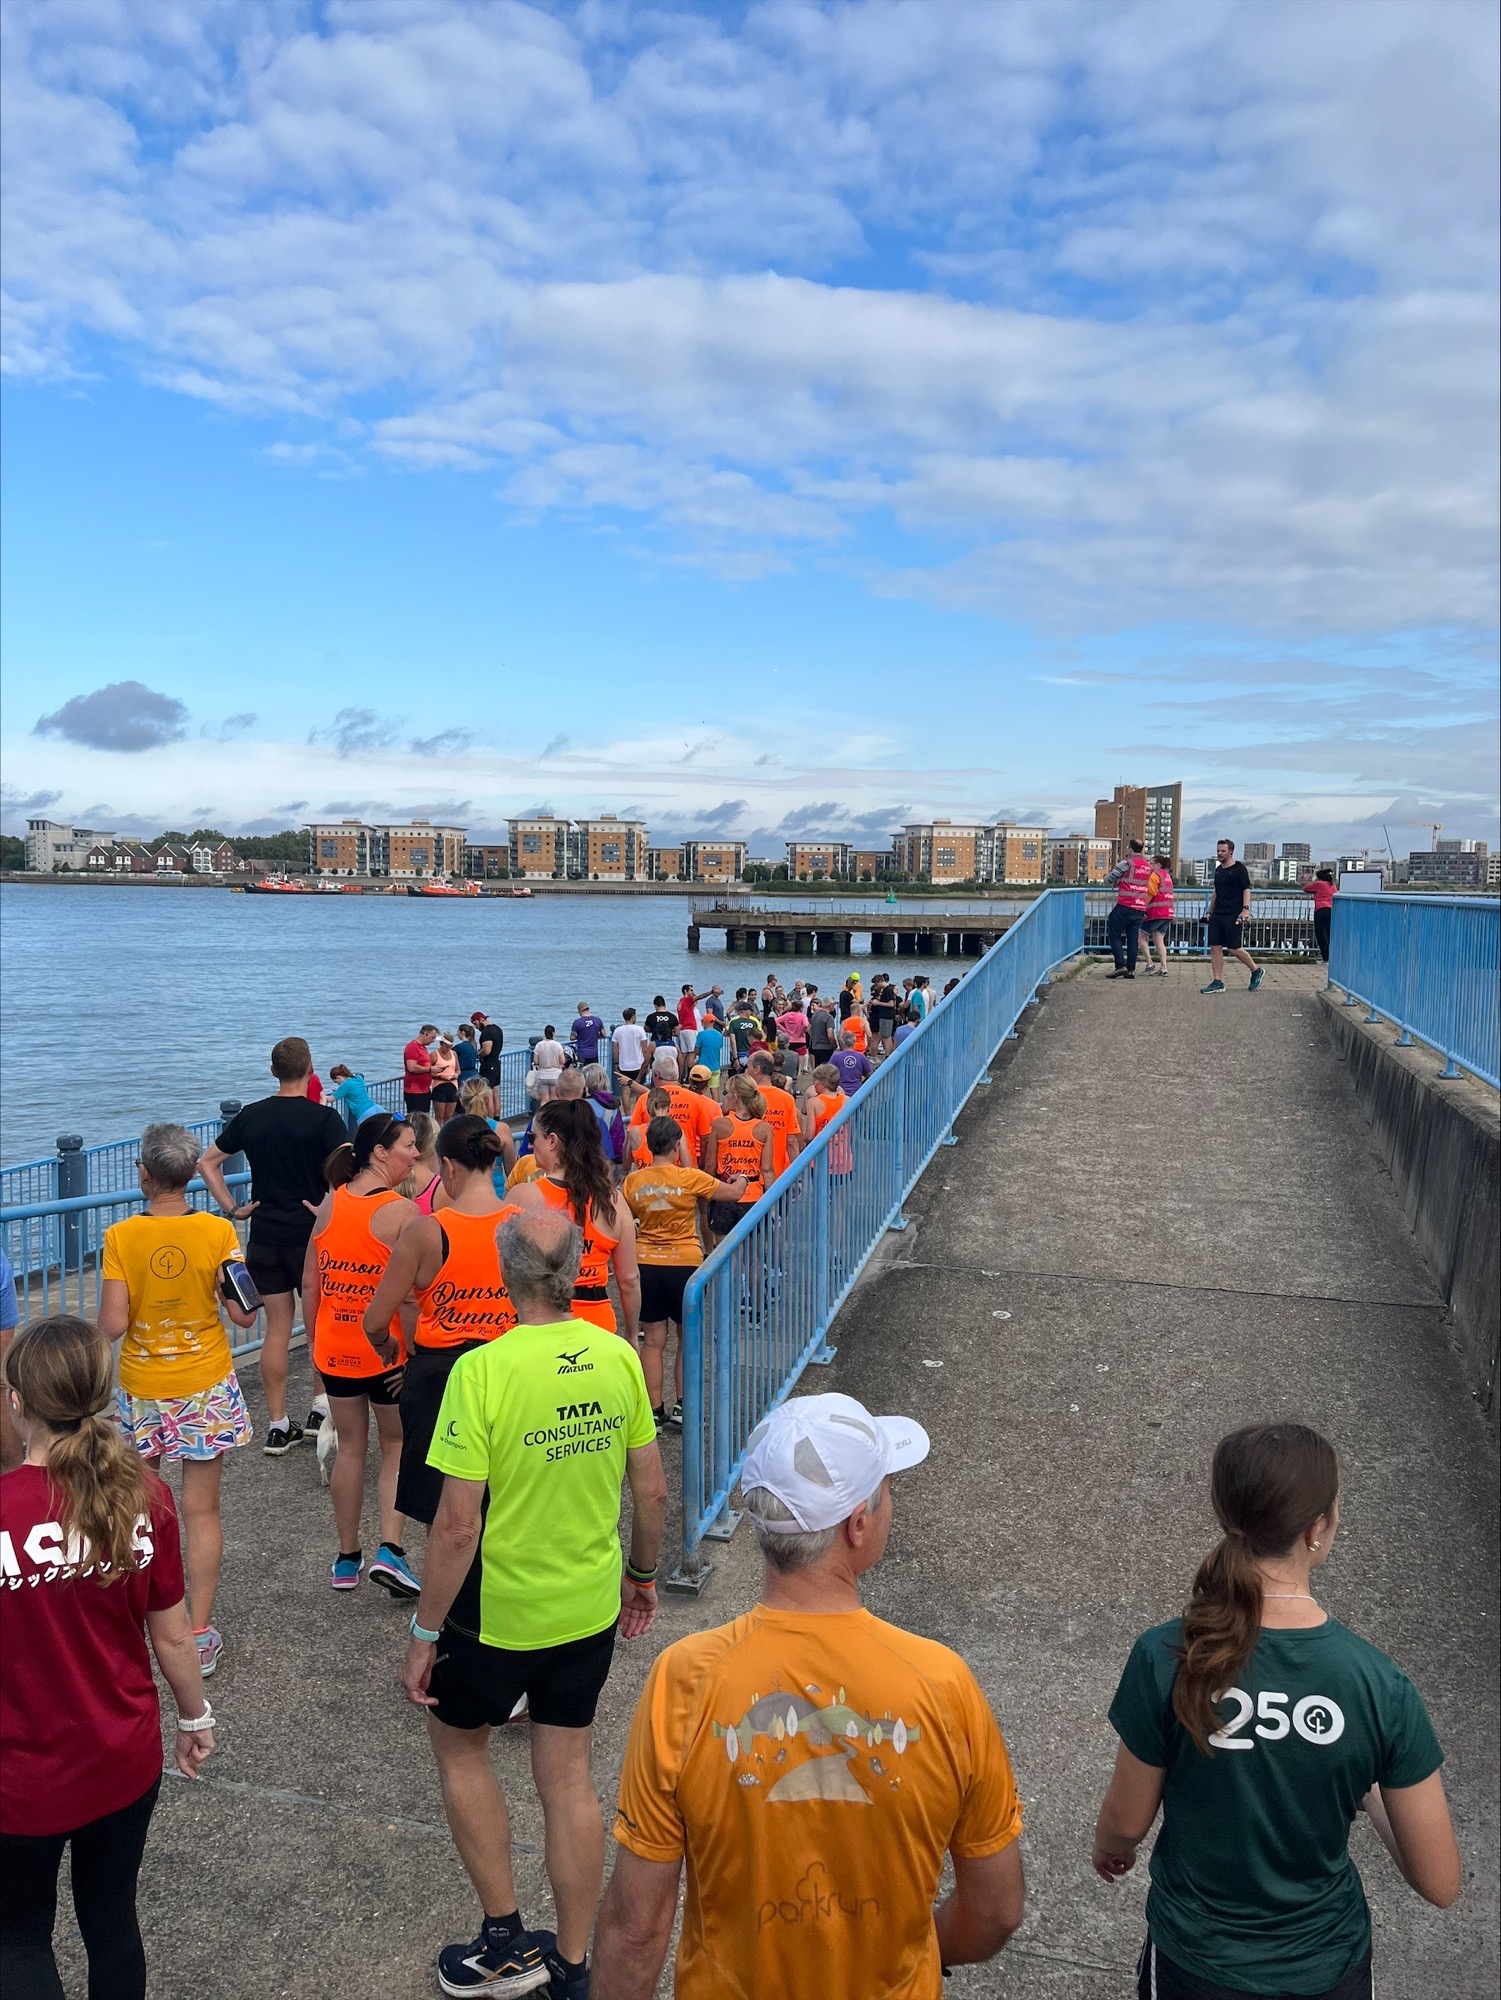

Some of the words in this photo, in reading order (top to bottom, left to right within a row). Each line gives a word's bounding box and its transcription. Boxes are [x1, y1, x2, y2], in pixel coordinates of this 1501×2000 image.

[585, 1020, 594, 1028] 25
[727, 1139, 755, 1148] SHAZZA
[722, 1153, 760, 1165] Danson
[319, 1249, 385, 1275] Danson
[320, 1272, 376, 1297] Runner
[431, 1281, 509, 1307] Danso
[431, 1306, 520, 1332] Runners
[556, 1401, 603, 1421] TATA
[523, 1415, 626, 1447] CONSULTANCY
[545, 1435, 612, 1462] SERVICES
[1208, 1686, 1345, 1750] 250
[757, 1878, 881, 1935] parkrun
